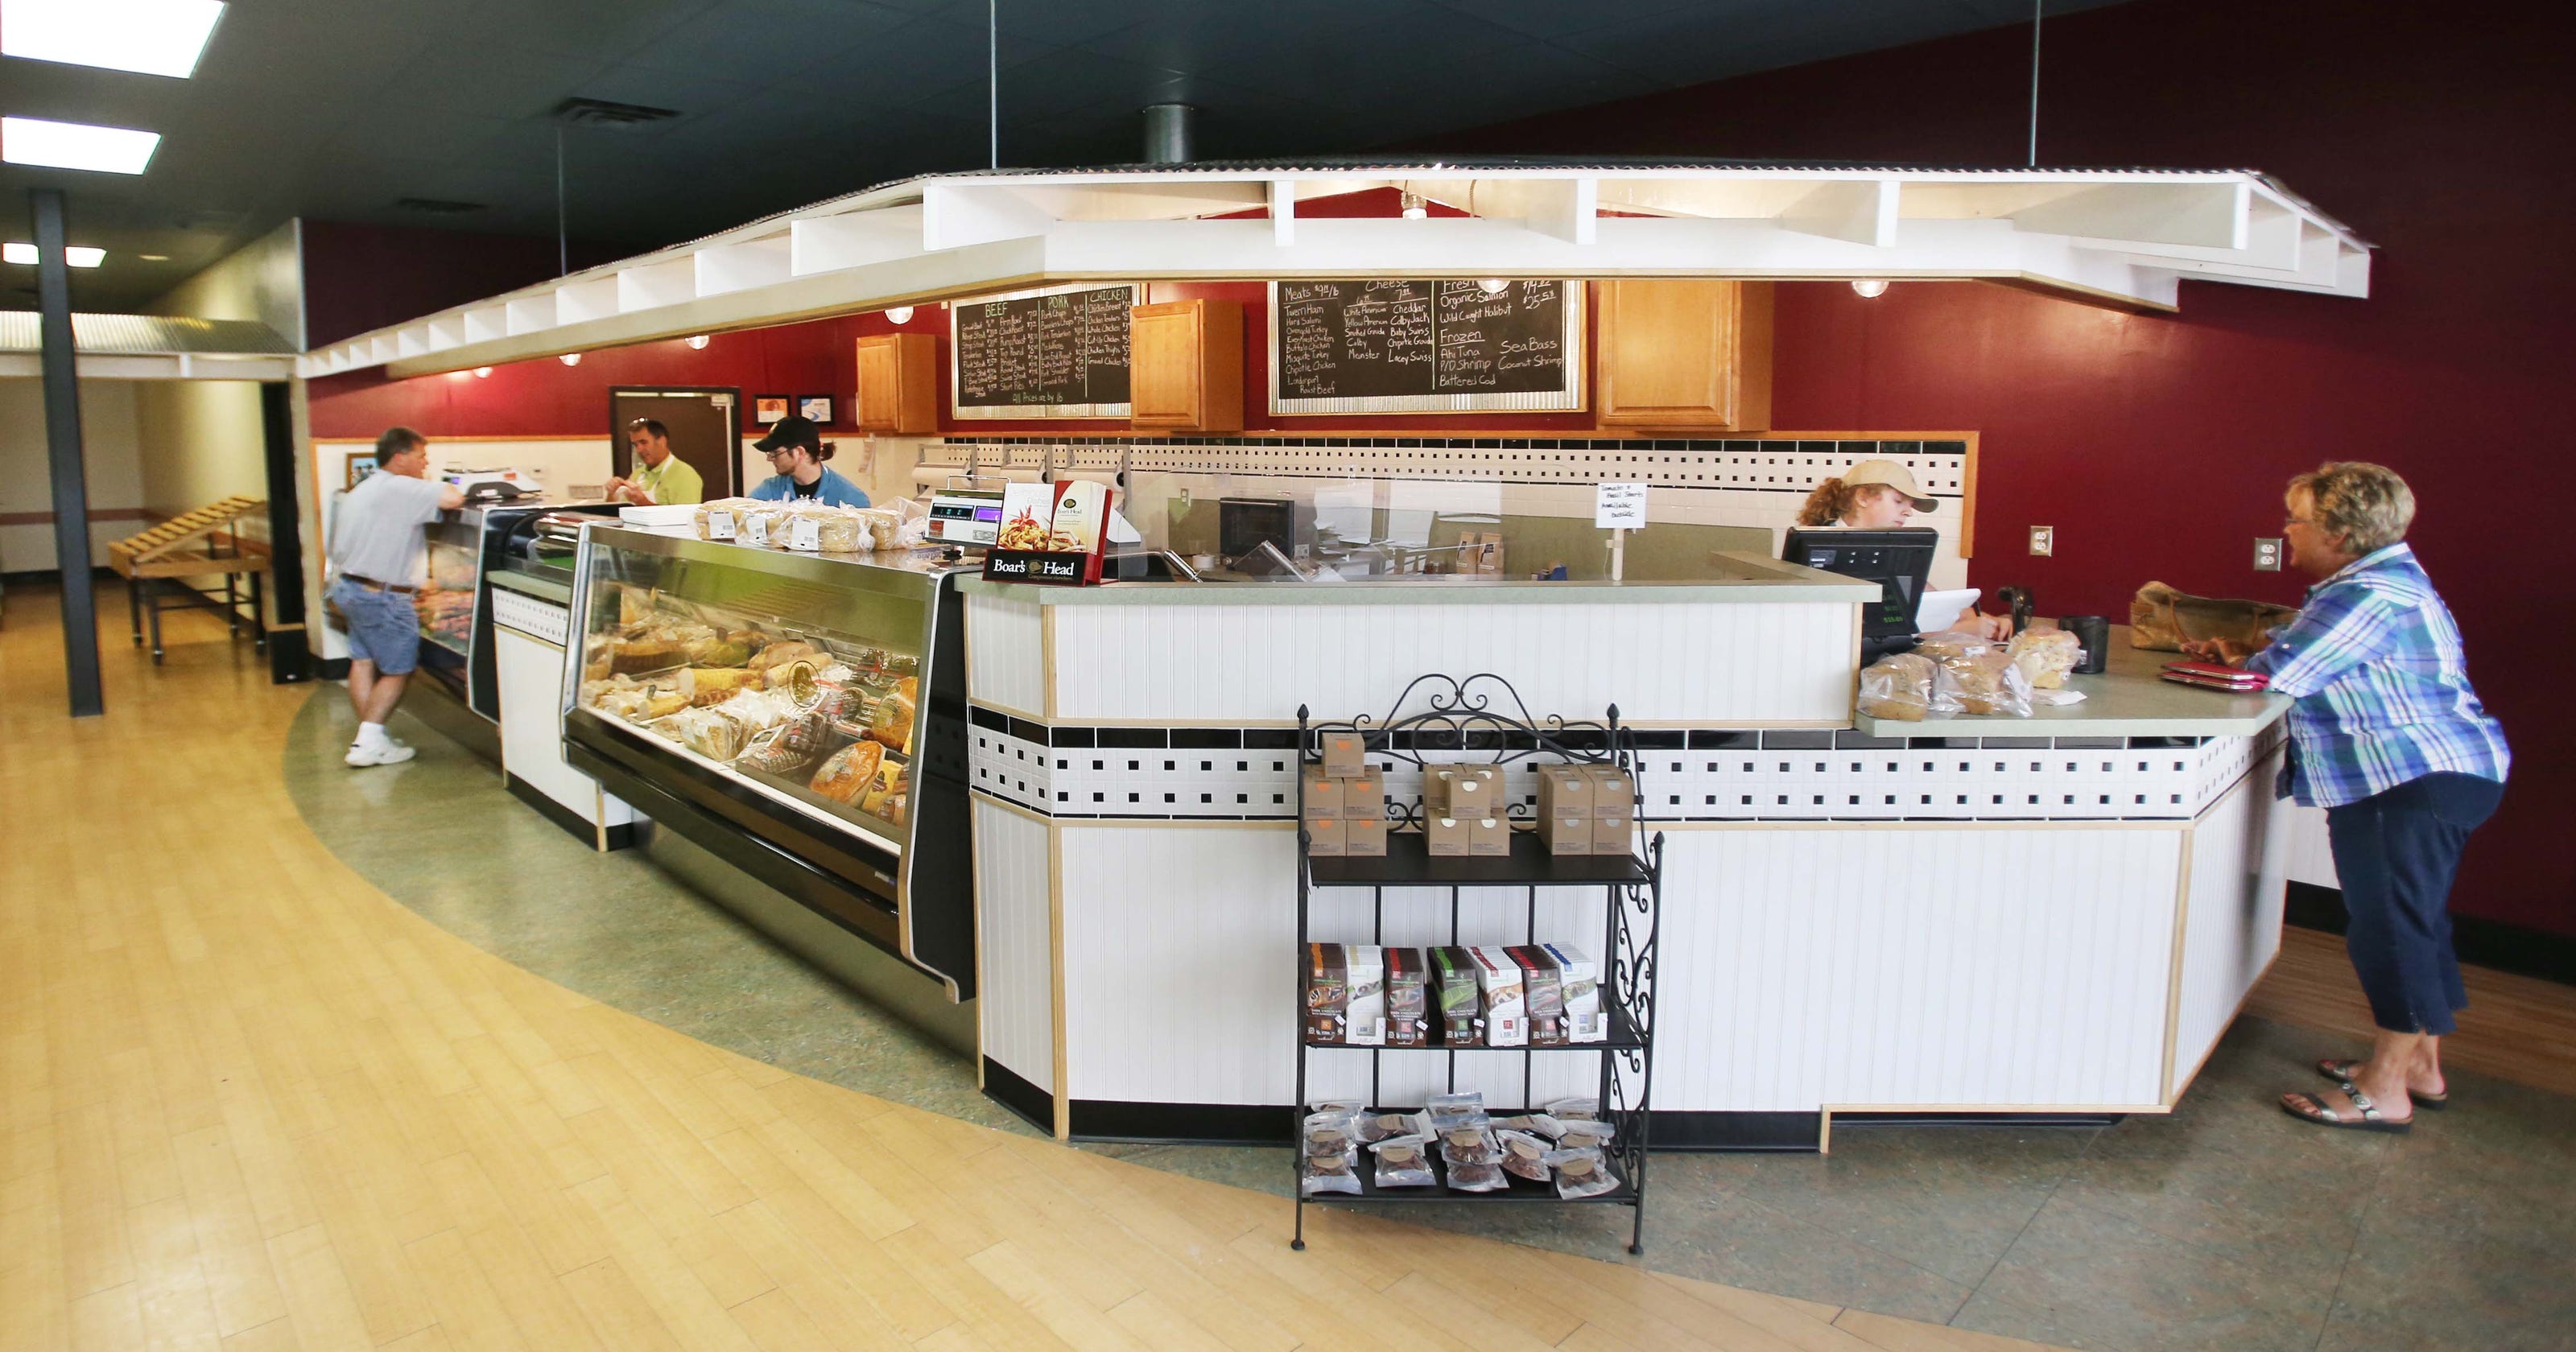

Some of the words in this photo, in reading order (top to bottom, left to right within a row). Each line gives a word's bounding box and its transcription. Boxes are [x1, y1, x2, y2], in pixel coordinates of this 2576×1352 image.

[1365, 280, 1410, 292] Cheese
[1090, 288, 1128, 303] CHICKEN
[1285, 286, 1311, 302] Meats
[1440, 291, 1476, 310] Organic
[1476, 290, 1509, 303] Salmon
[985, 302, 1008, 318] BEEF
[1048, 295, 1069, 310] PORK
[1393, 303, 1426, 315] Cheddar
[1439, 311, 1458, 324] Wild
[1459, 307, 1483, 323] Caught
[1484, 302, 1513, 318] Halibut
[1389, 327, 1406, 339] Baby
[1407, 324, 1430, 337] Swiss
[1439, 328, 1482, 344] Frozen
[1346, 337, 1368, 349] Colby
[1500, 340, 1528, 355] Sea
[1528, 336, 1558, 352] Bass
[1410, 349, 1432, 362] Swiss
[1440, 346, 1455, 360] Ahi
[1455, 344, 1481, 357] Tuna
[1457, 358, 1492, 373] Shrimp
[1497, 356, 1531, 370] Coconut
[1533, 354, 1563, 368] Shrimp
[1439, 374, 1476, 387] Battered
[1478, 373, 1496, 385] Cod
[993, 559, 1026, 574] Boar's
[1042, 561, 1075, 575] Head
